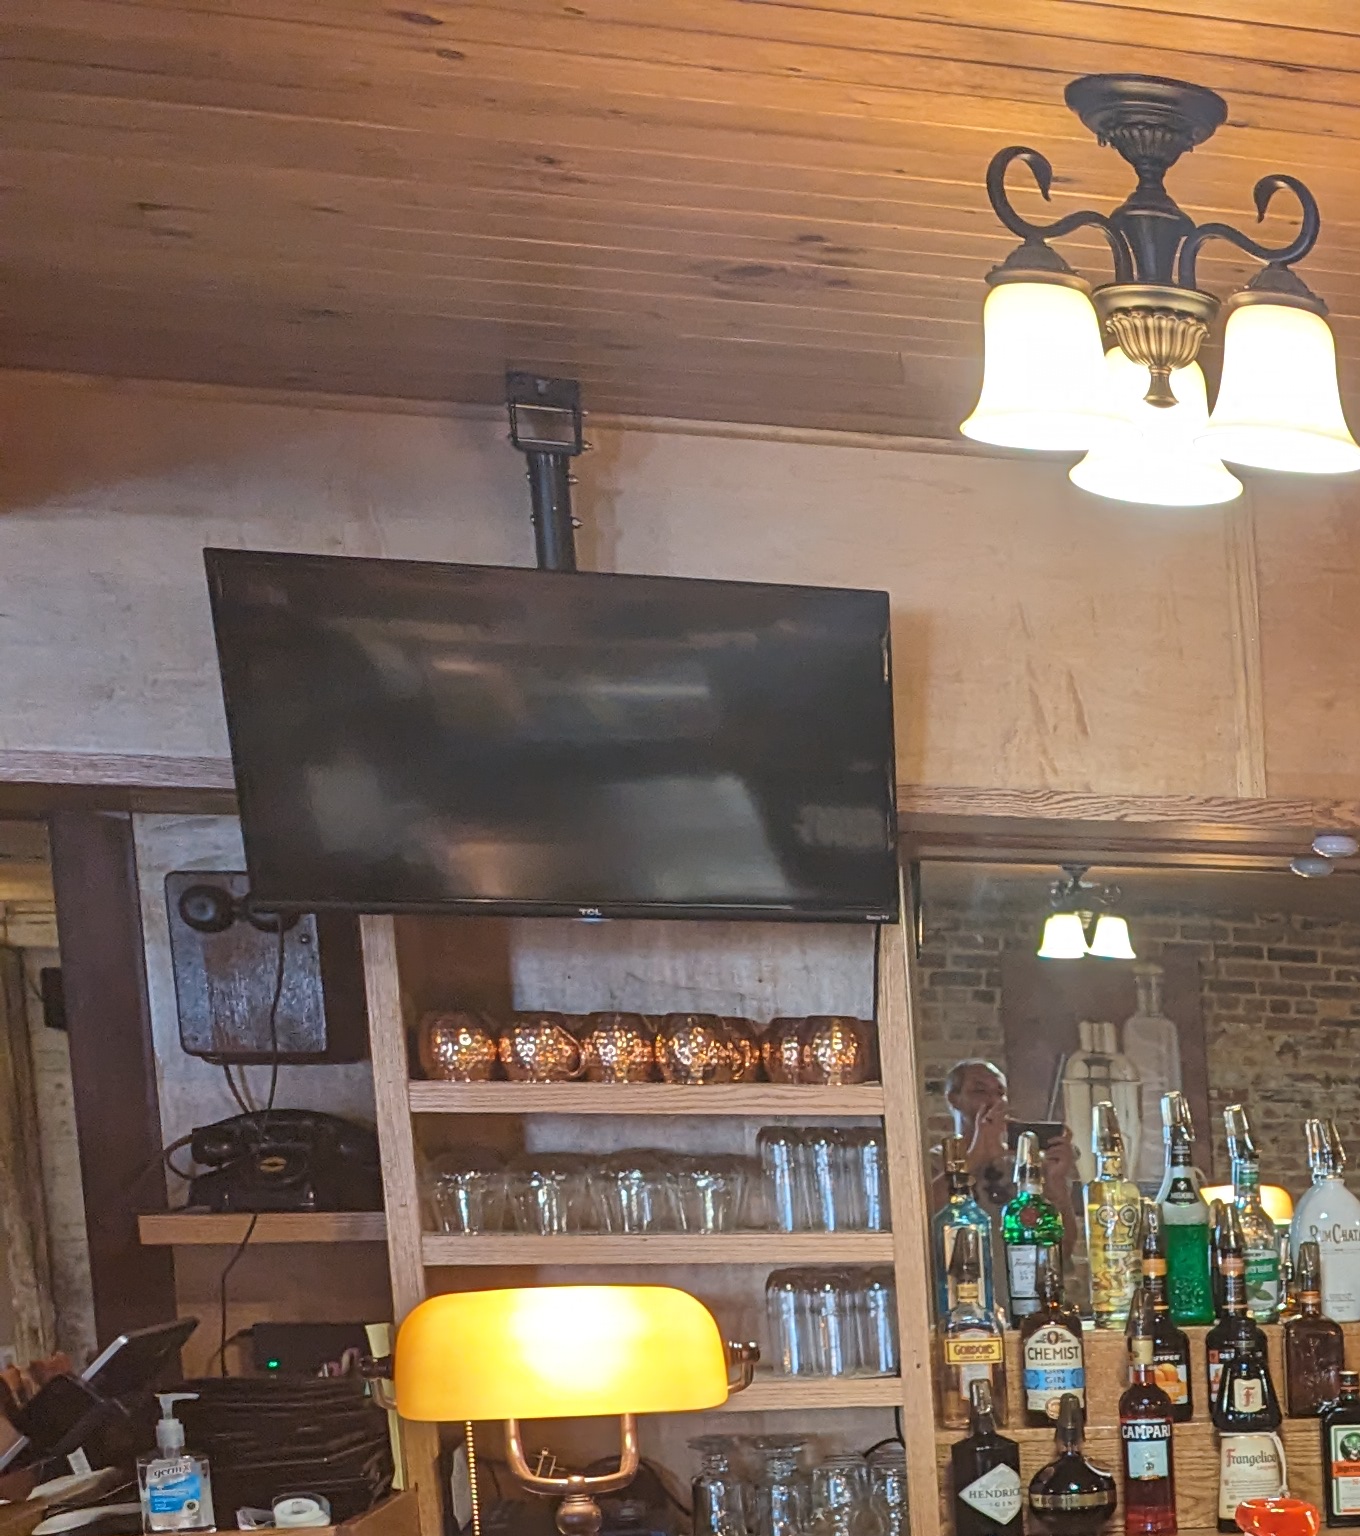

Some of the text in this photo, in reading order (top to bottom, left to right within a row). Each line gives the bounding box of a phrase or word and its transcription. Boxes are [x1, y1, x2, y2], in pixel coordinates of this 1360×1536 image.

[579, 908, 602, 916] TCL
[1096, 1204, 1138, 1237] 99
[1027, 1346, 1079, 1360] CHEMIST
[1153, 1354, 1180, 1362] UYPER
[1045, 1376, 1066, 1384] GIN
[1122, 1424, 1171, 1439] CAMPARI
[1226, 1448, 1277, 1467] Frangelico
